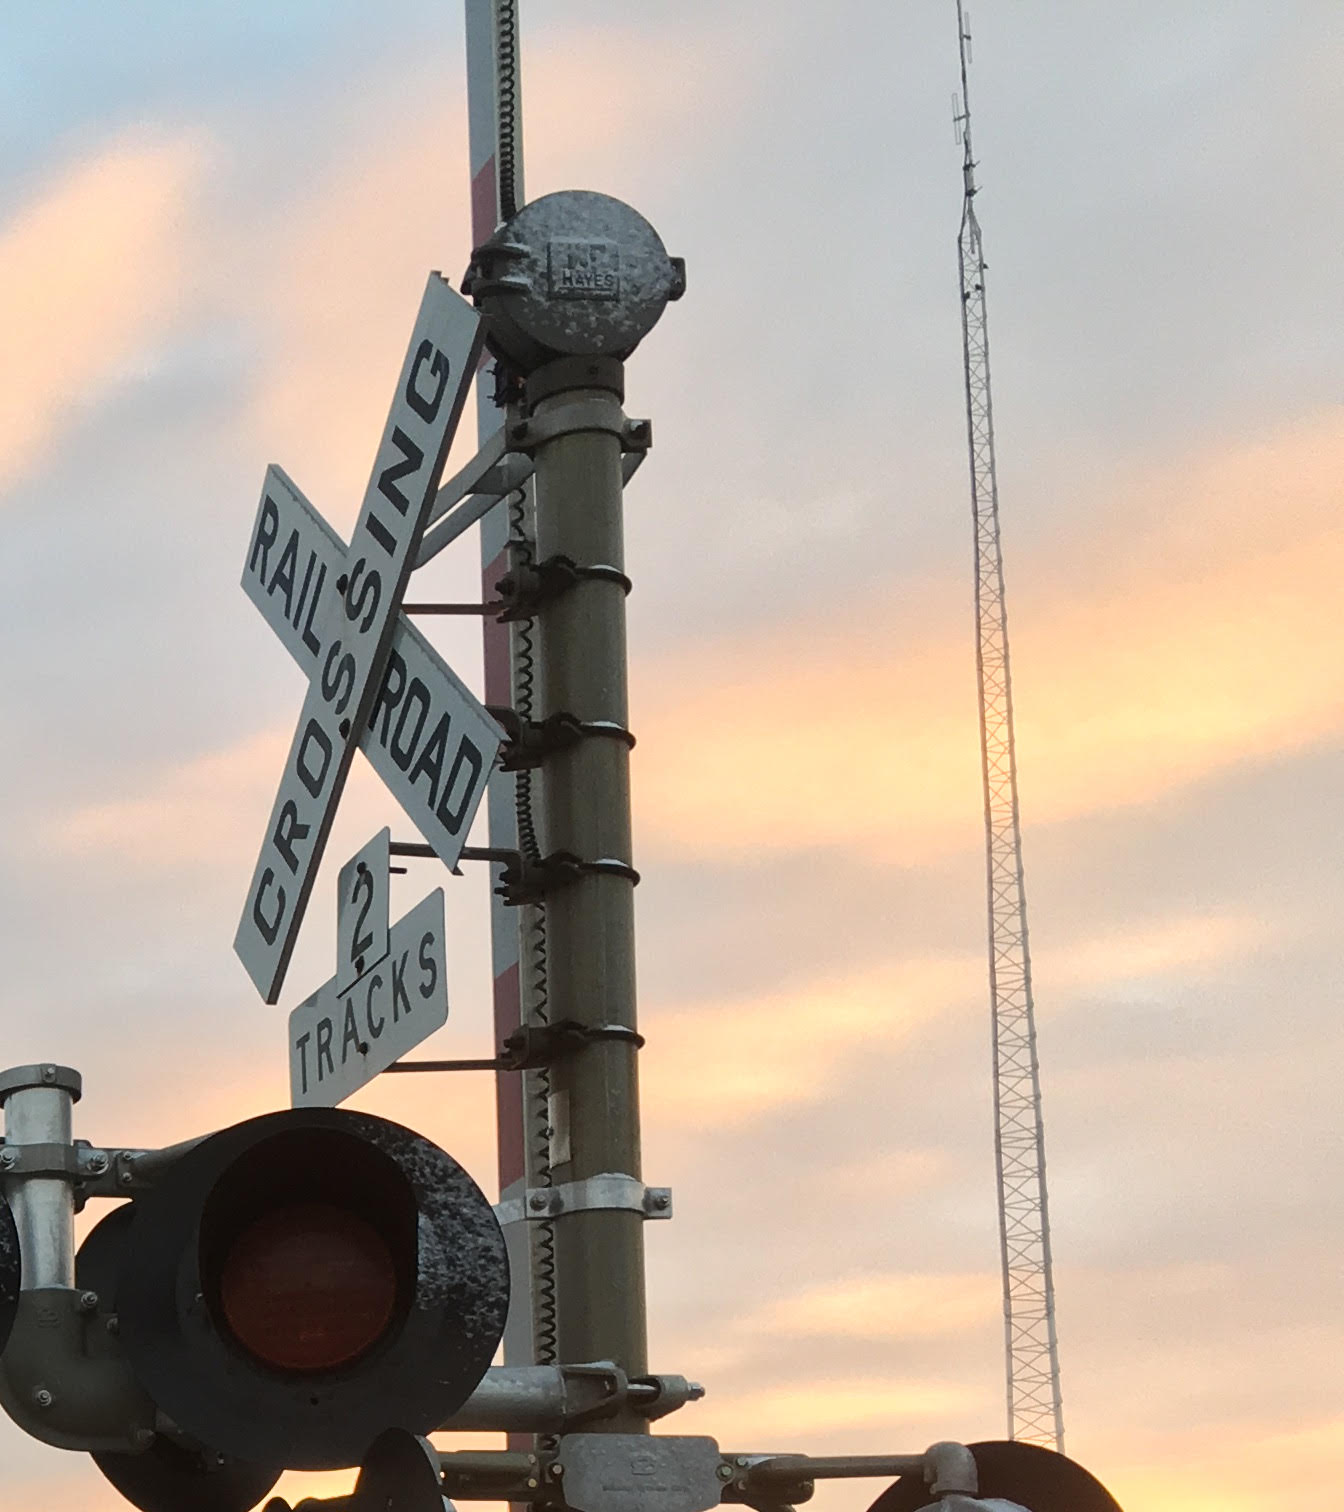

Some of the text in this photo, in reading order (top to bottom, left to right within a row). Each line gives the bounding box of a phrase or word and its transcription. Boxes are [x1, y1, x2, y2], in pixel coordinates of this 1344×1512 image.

[249, 494, 484, 836] RAIL ROAD
[253, 338, 450, 946] CROSSING
[295, 930, 438, 1096] TRACKS
[350, 864, 375, 963] 2
